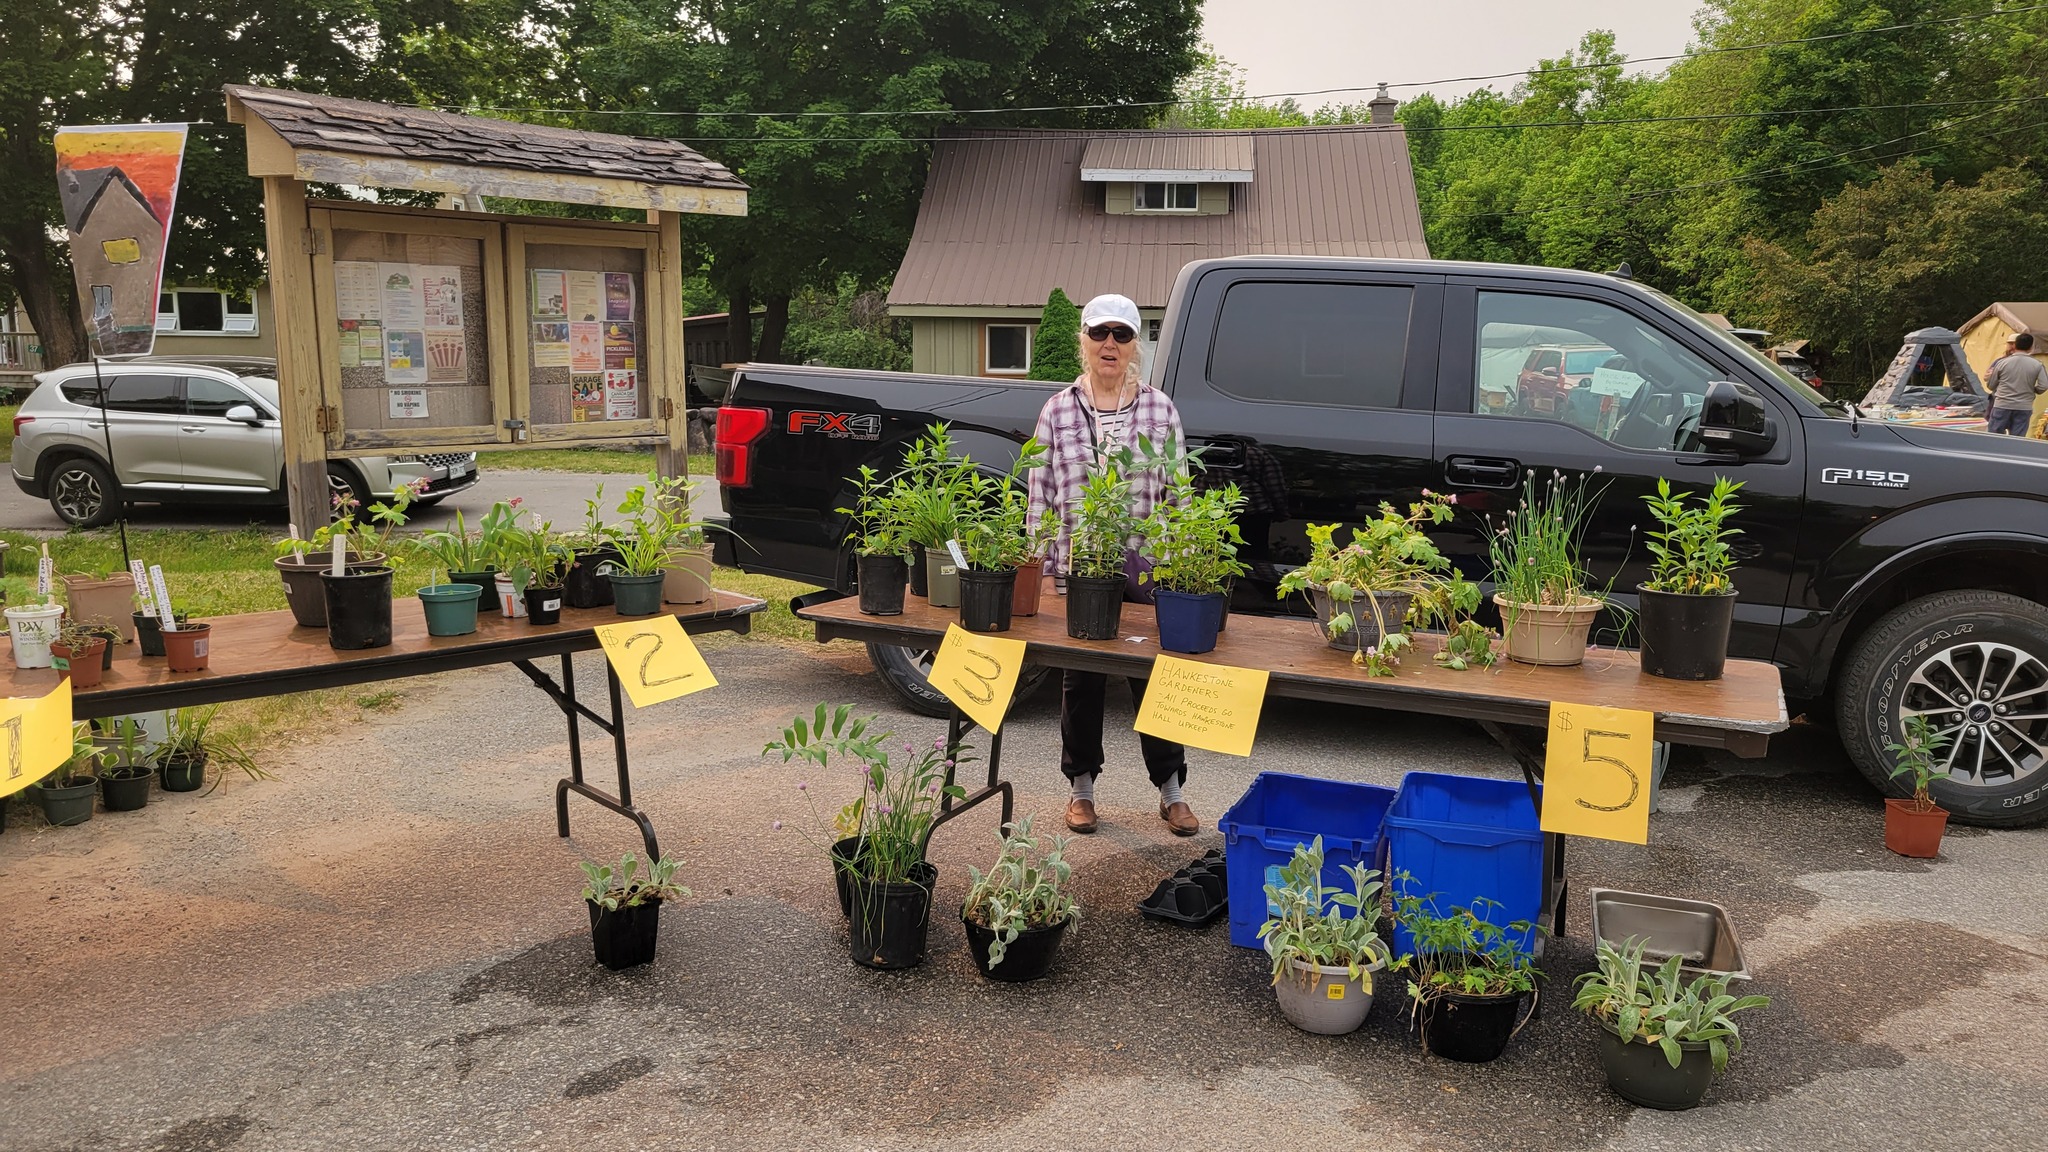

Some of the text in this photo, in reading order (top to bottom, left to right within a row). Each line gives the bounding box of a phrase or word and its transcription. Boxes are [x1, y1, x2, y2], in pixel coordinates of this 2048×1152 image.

[573, 376, 602, 384] GARAGE
[787, 410, 881, 436] FX4
[17, 620, 43, 633] PW
[600, 627, 694, 688] $ 2
[950, 633, 1002, 706] $ 3
[1160, 660, 1234, 688] HAWKESTONE
[1158, 676, 1219, 699] GARDENERS
[1155, 700, 1236, 730] TOWARDS HAWKESTONE
[1181, 698, 1218, 714] PROCEEDS
[1221, 708, 1233, 717] GO
[1152, 711, 1208, 734] HALL UPKEEP
[1556, 711, 1639, 812] $ 5
